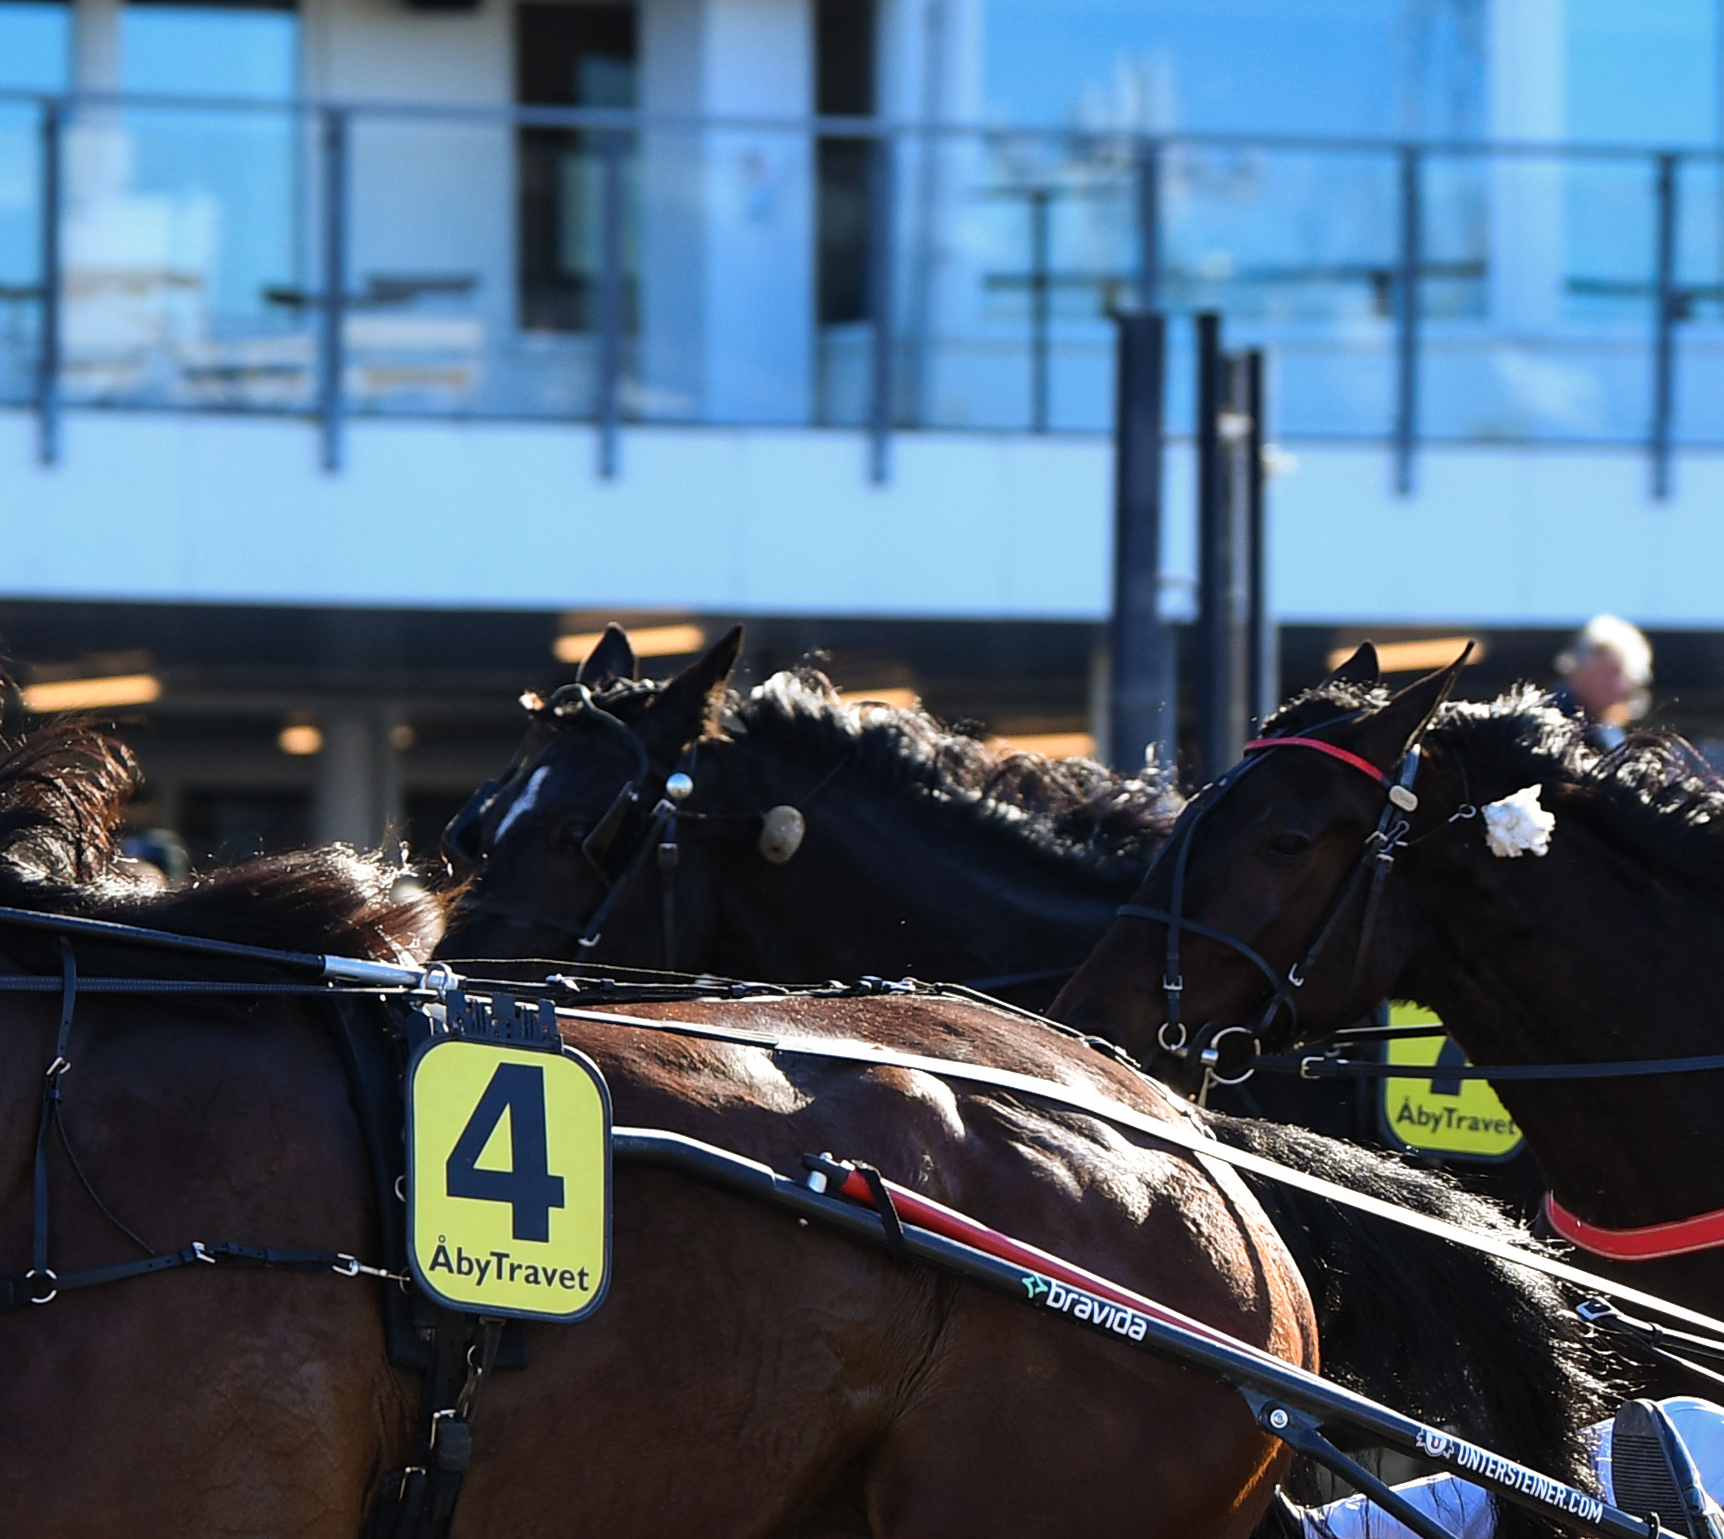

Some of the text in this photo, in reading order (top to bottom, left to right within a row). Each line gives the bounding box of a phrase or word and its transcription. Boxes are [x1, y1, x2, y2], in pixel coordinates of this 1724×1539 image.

[1396, 1096, 1516, 1135] ÅbyTravet
[446, 1062, 565, 1243] 4
[428, 1235, 590, 1291] ÅbyTravet
[1045, 1280, 1148, 1342] bravida
[1456, 1443, 1604, 1525] UNTERSTEINER.COM
